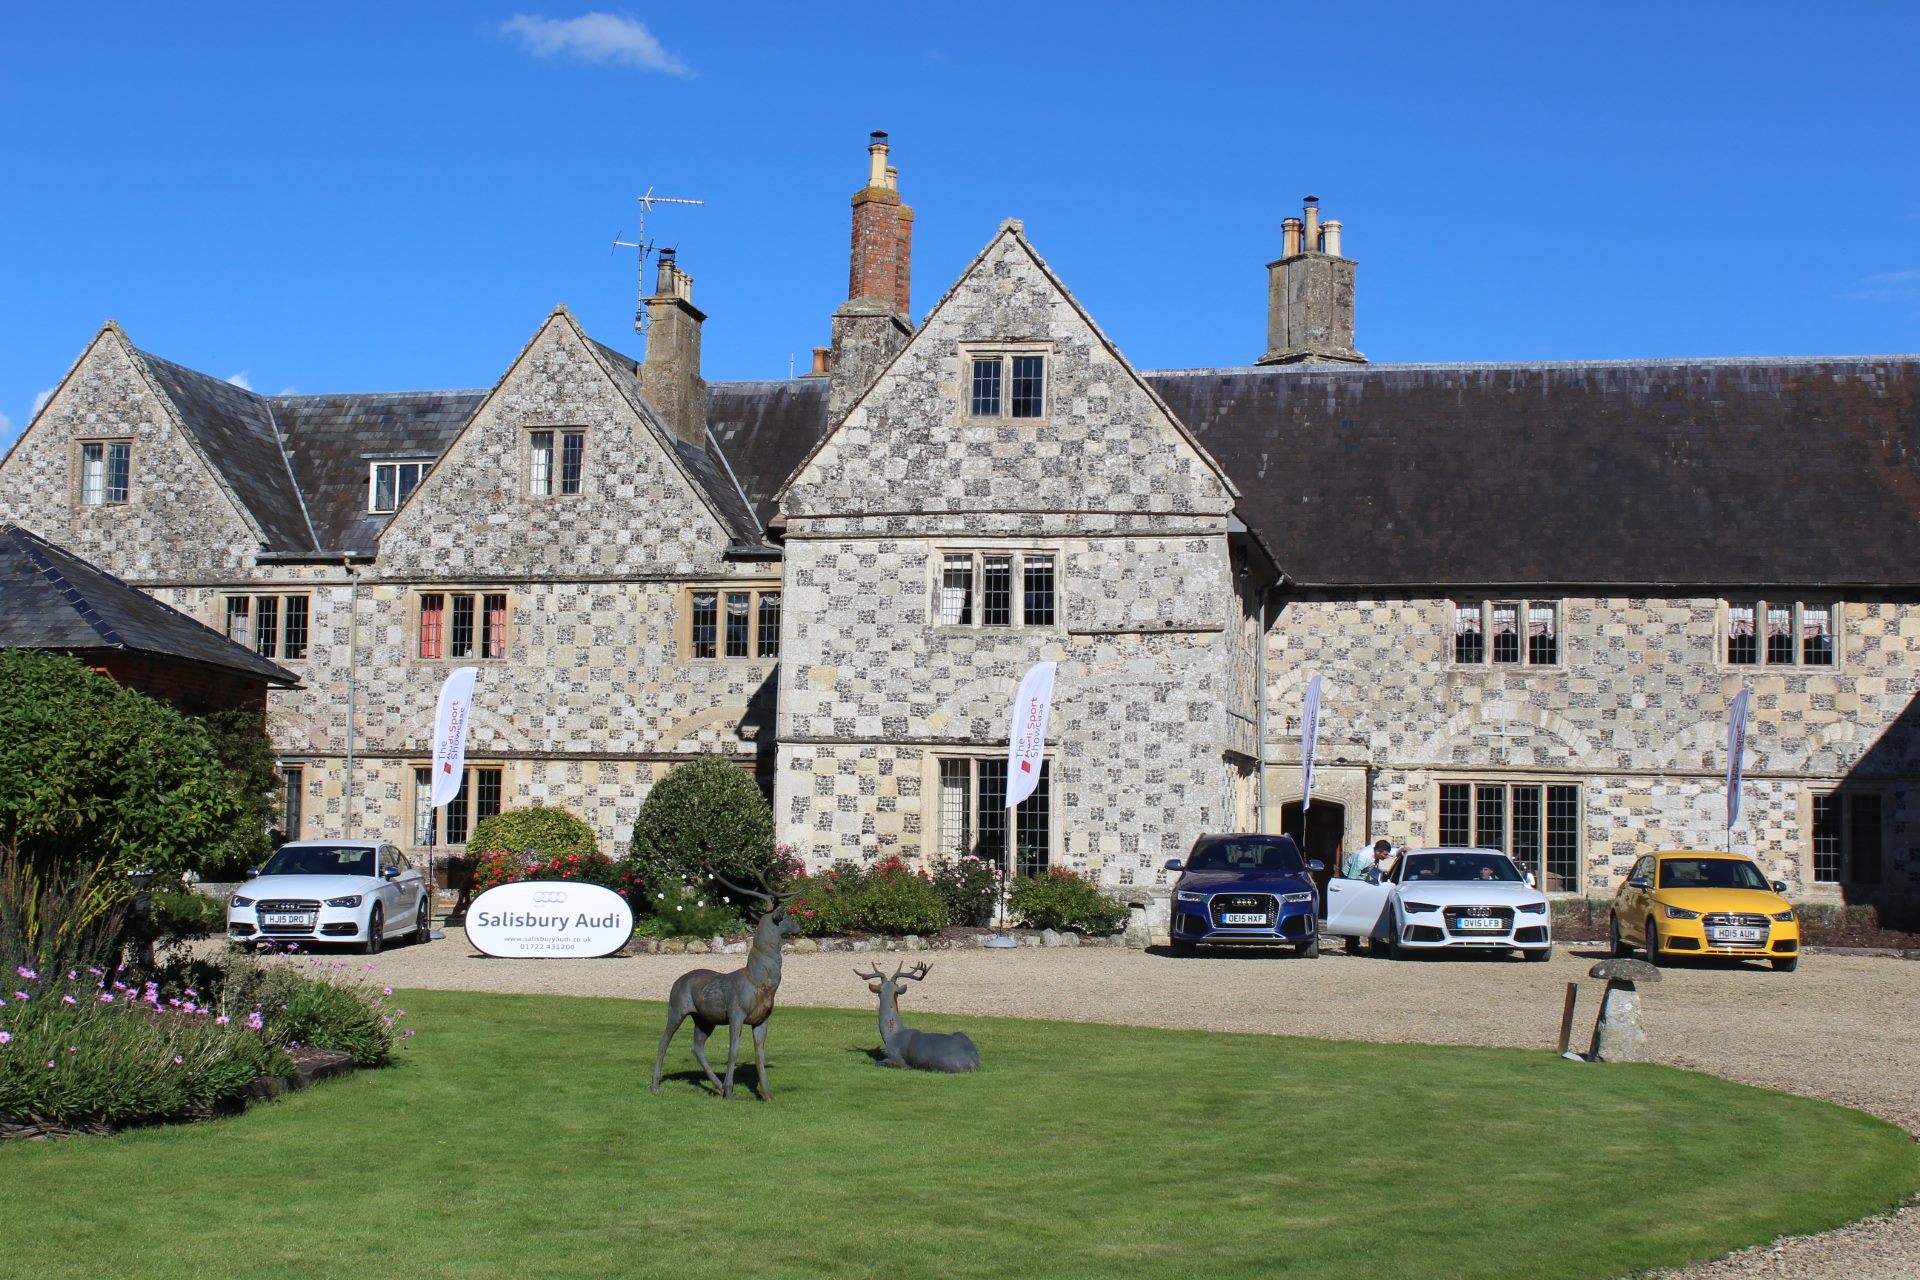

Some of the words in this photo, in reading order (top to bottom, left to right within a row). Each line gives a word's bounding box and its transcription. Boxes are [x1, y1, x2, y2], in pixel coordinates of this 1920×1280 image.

[449, 700, 459, 732] Sport
[1027, 697, 1038, 730] Sport
[438, 741, 448, 760] The
[1016, 738, 1025, 758] The
[269, 915, 287, 924] HJ15
[289, 915, 304, 924] DRO
[478, 912, 570, 932] Salisbury
[575, 913, 620, 928] Audi
[1228, 914, 1246, 923] OE15
[1464, 919, 1482, 927] OV15
[1483, 919, 1500, 927] LFB
[1719, 929, 1737, 937] HD15
[1740, 930, 1755, 938] AUH
